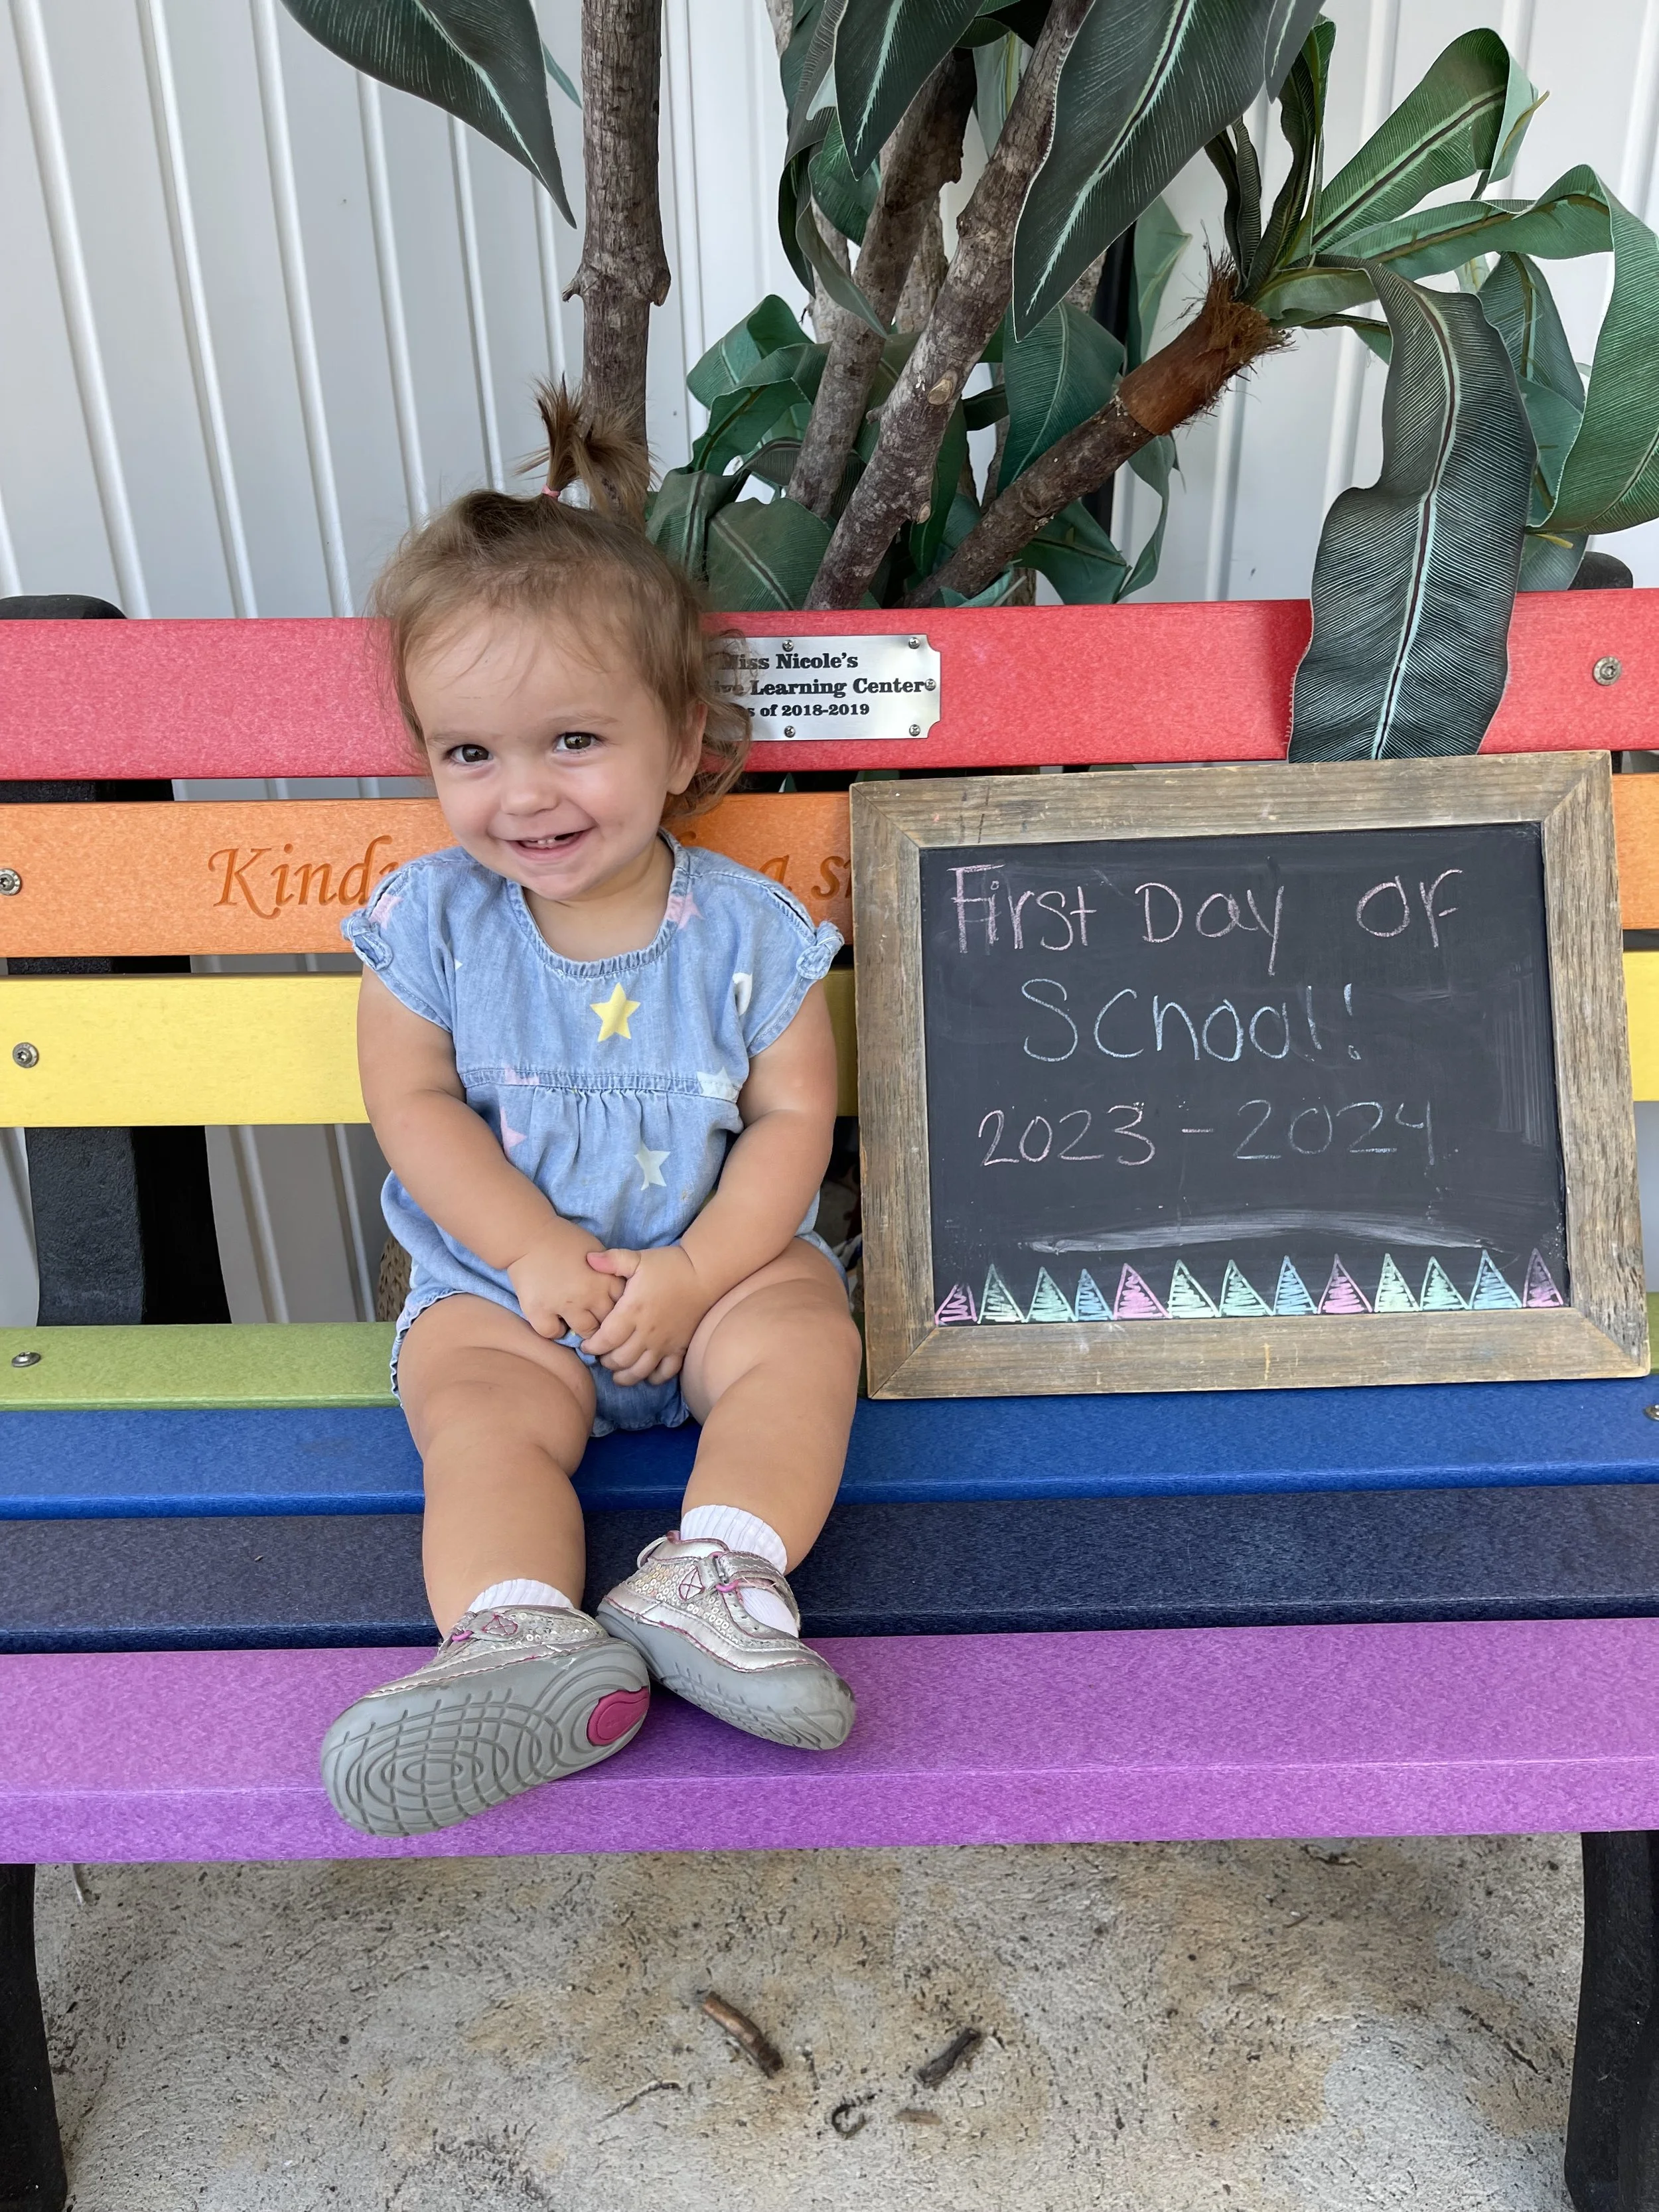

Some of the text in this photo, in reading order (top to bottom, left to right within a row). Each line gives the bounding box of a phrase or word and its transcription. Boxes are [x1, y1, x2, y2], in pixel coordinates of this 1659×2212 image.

[775, 652, 859, 670] Nicole's
[749, 678, 847, 698] Learning
[852, 678, 926, 695] Center
[759, 704, 778, 717] of
[781, 703, 870, 717] 2018-2019
[946, 863, 1098, 954] First
[1134, 882, 1285, 976] Day
